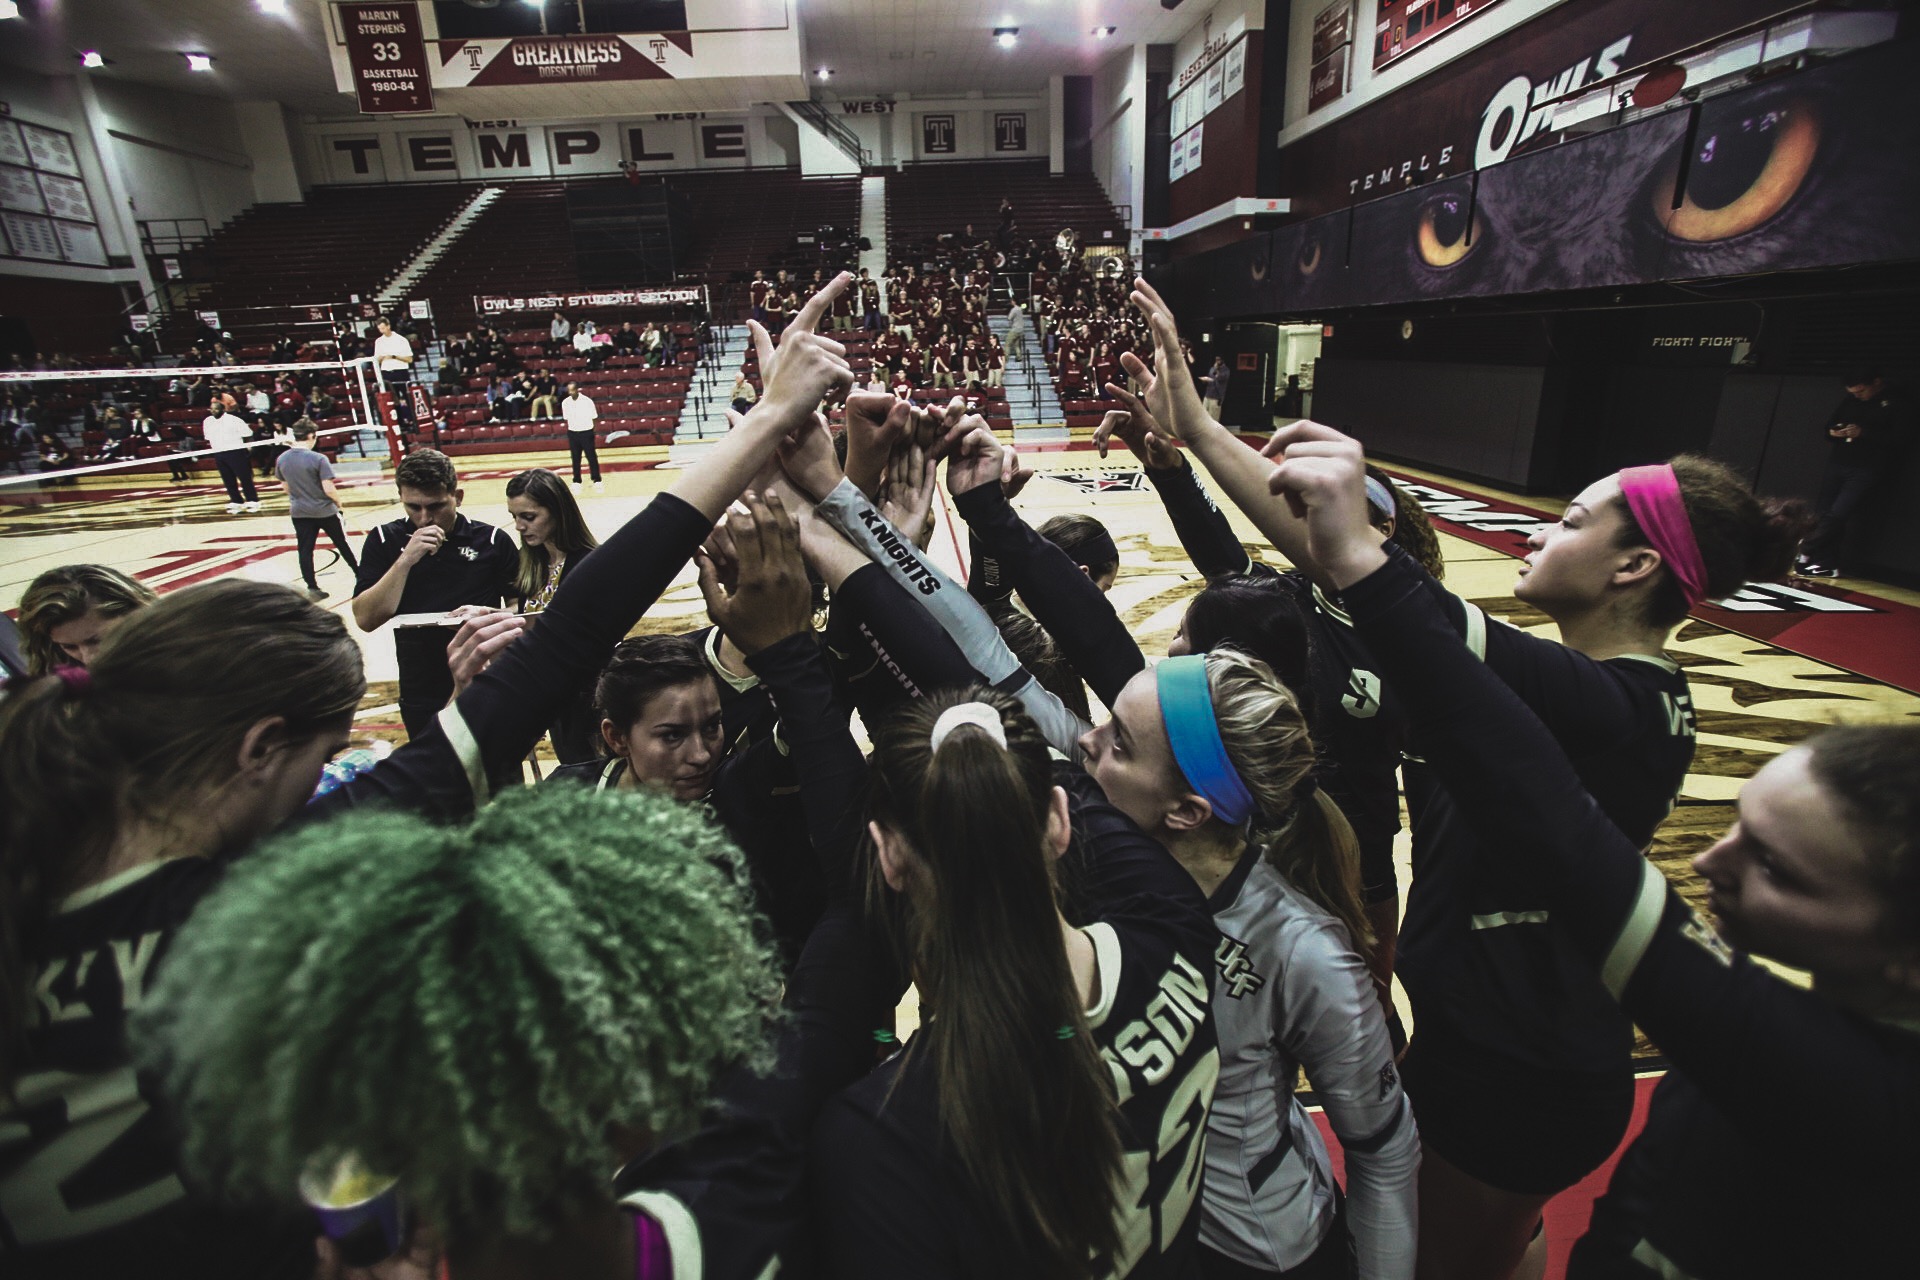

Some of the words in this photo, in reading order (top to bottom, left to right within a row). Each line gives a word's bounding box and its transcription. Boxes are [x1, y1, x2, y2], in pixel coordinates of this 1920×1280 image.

[358, 10, 400, 21] MARILYN
[357, 23, 407, 35] STEPHENS
[372, 42, 401, 61] 33
[512, 40, 622, 66] GREATNESS
[1179, 32, 1229, 87] BASKETBALL
[362, 68, 419, 79] BASKETBALL
[538, 64, 575, 78] DOESN'T
[371, 81, 415, 92] 1980-84
[842, 100, 897, 114] WEST
[333, 125, 746, 174] TEMPLE
[1349, 145, 1455, 195] TEMPLE
[483, 297, 525, 311] OWLS
[529, 296, 565, 309] NEST
[568, 292, 636, 307] STUDENT
[638, 288, 699, 303] SECTION
[1652, 337, 1694, 347] FIGHT!
[858, 507, 942, 597] KNIGHTS
[858, 621, 925, 699] KNIGHT
[1214, 934, 1267, 1000] UCF
